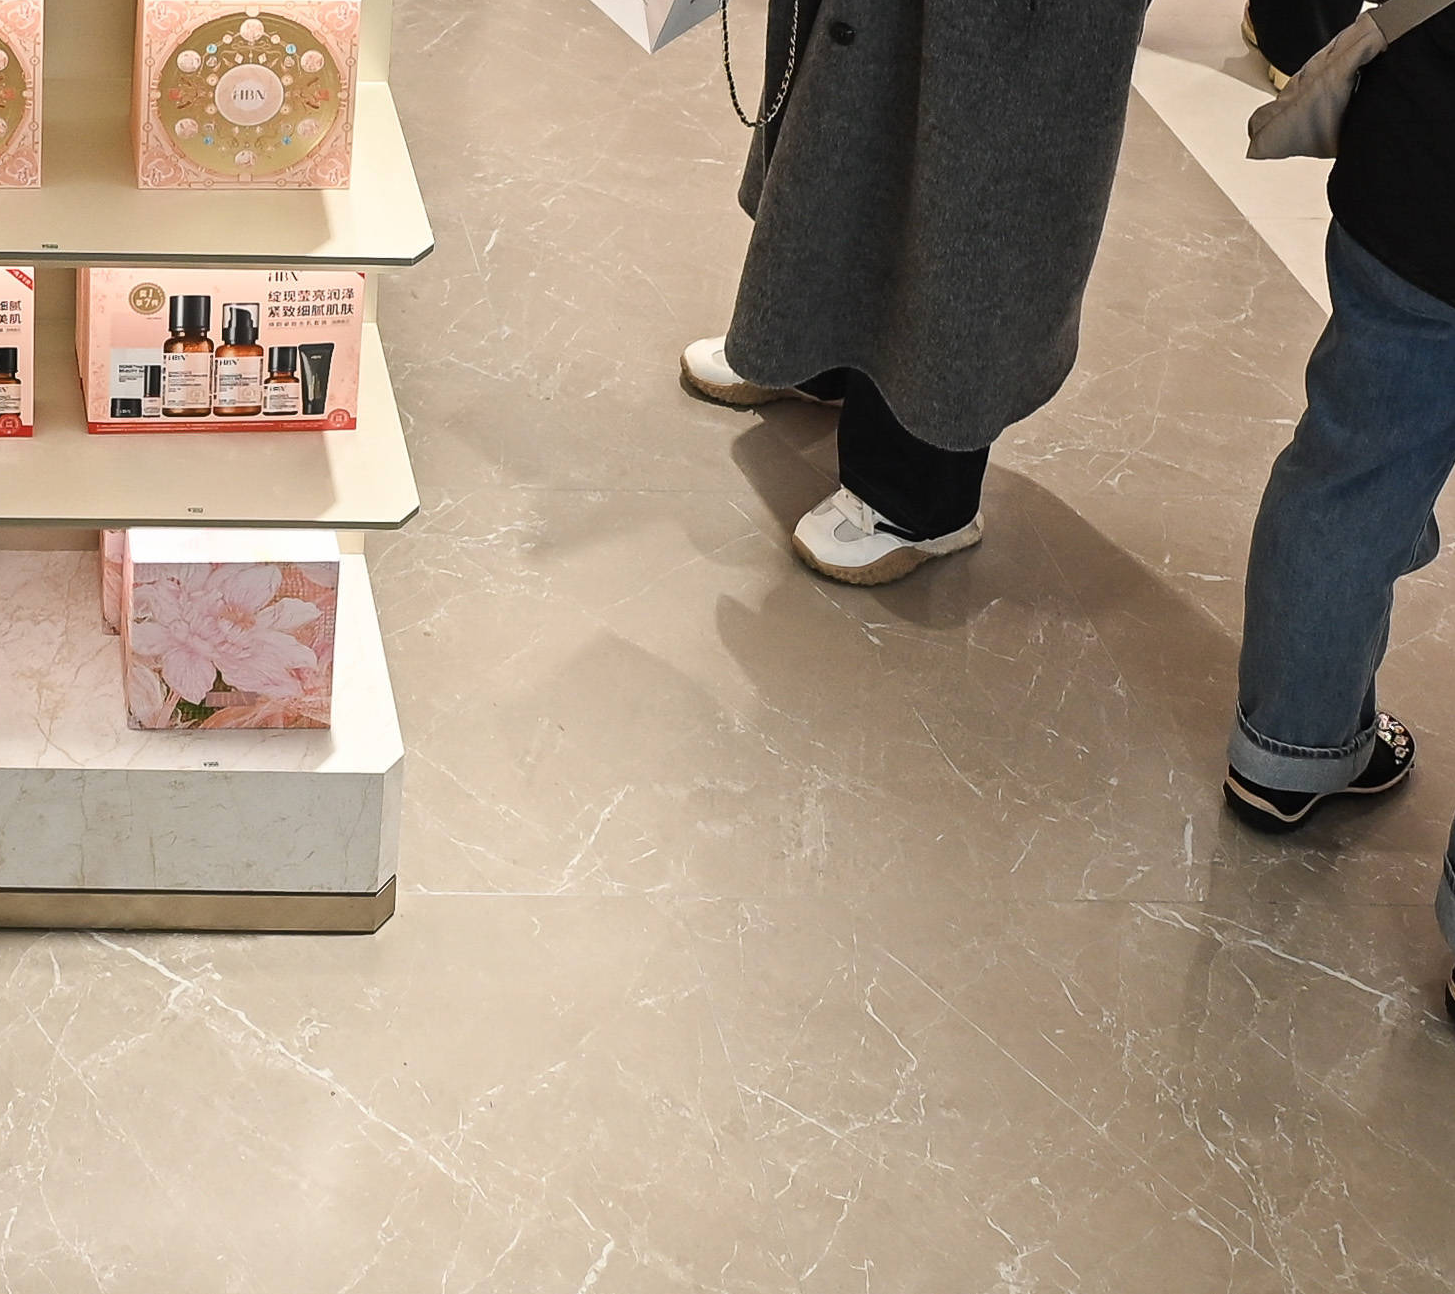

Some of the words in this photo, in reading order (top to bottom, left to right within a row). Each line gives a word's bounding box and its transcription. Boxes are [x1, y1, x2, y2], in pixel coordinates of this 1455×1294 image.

[232, 88, 266, 101] HBN
[267, 271, 299, 282] HBN
[267, 288, 355, 303] 绽现莹亮润泽
[267, 304, 355, 319] 紧致细腻肌肤
